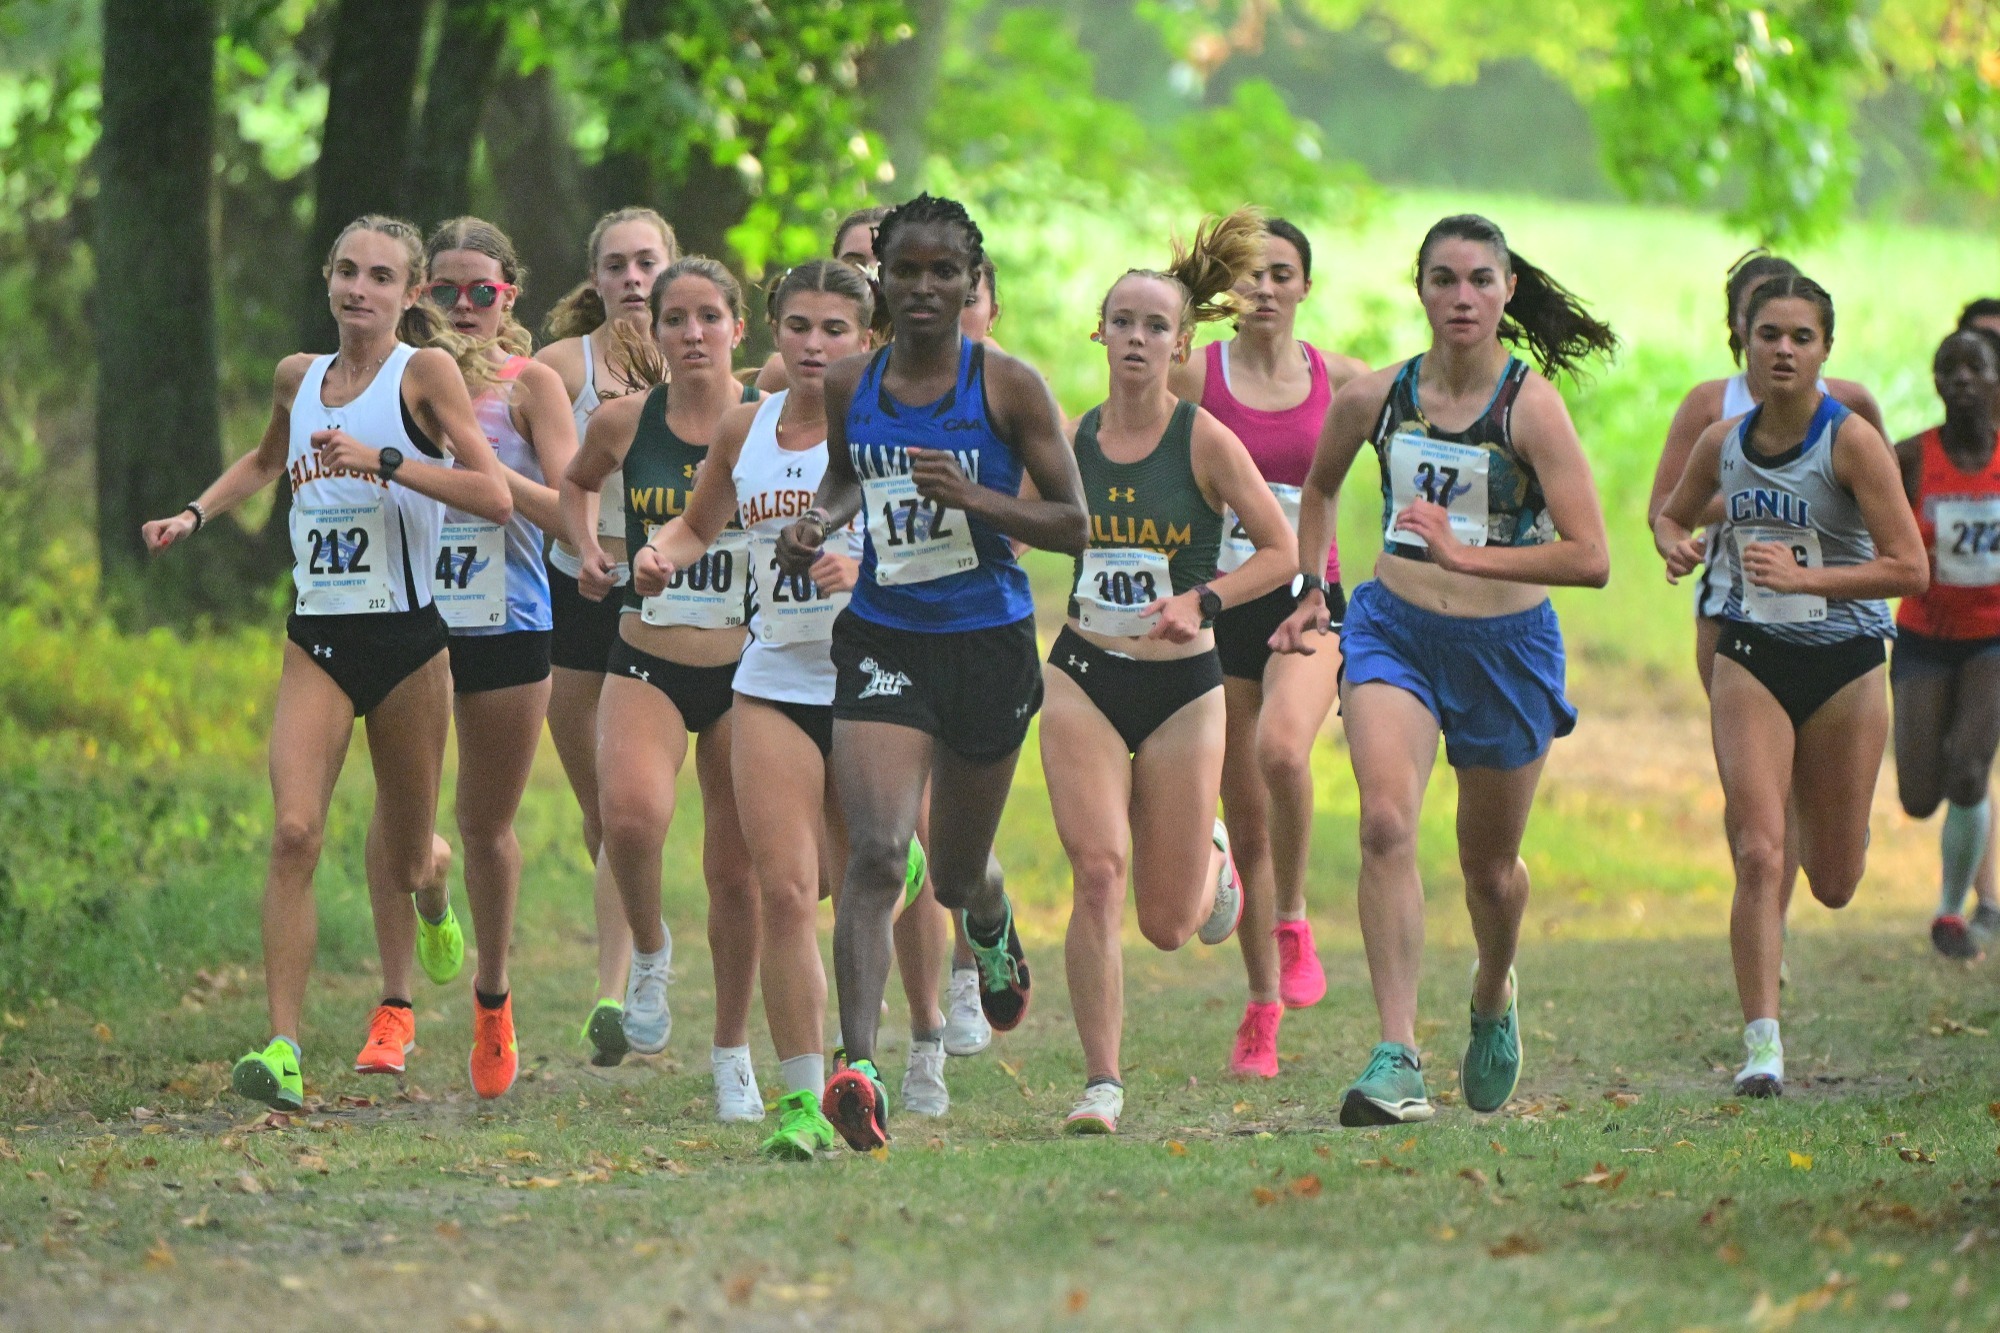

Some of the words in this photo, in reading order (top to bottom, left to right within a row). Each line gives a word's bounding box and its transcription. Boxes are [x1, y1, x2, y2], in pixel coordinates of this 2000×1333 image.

[1416, 462, 1459, 508] 37
[883, 499, 953, 546] 172
[1729, 488, 1810, 528] CNU
[308, 527, 370, 574] 212
[435, 546, 477, 589] 47
[957, 557, 974, 568] 172
[368, 599, 386, 609] 212
[1094, 571, 1157, 606] 303
[489, 613, 499, 622] 47
[725, 616, 741, 625] 300
[1808, 609, 1824, 618] 126
